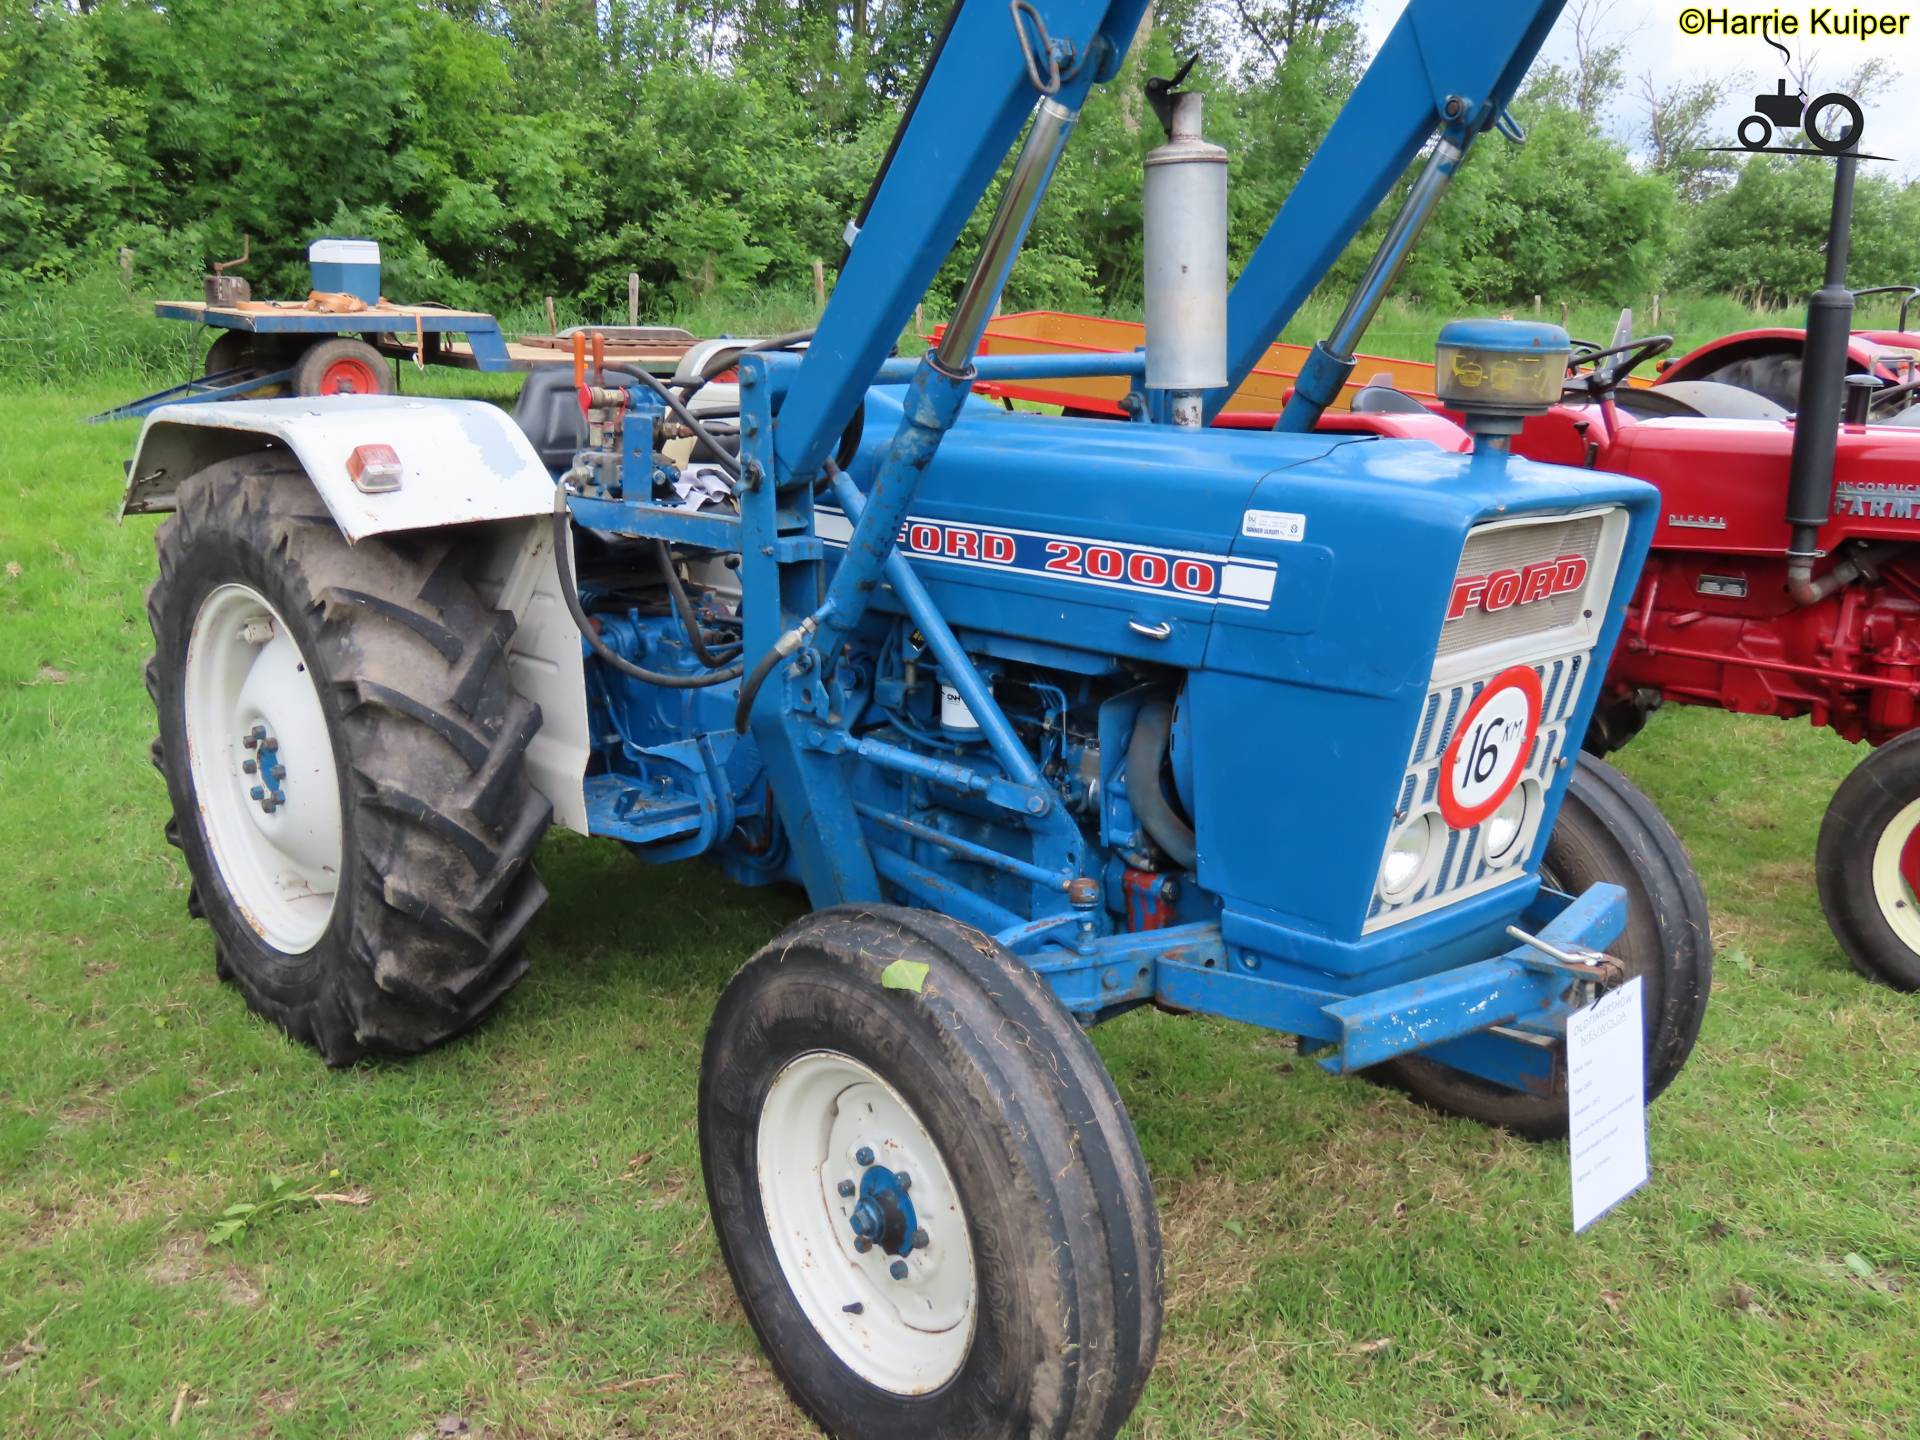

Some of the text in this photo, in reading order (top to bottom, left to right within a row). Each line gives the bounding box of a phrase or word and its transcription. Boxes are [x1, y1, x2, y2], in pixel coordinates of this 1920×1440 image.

[1669, 514, 1727, 527] DIESEL
[1834, 496, 1920, 519] FARM
[1045, 541, 1215, 595] 2000
[1445, 554, 1588, 621] FORD
[1462, 717, 1505, 789] 16
